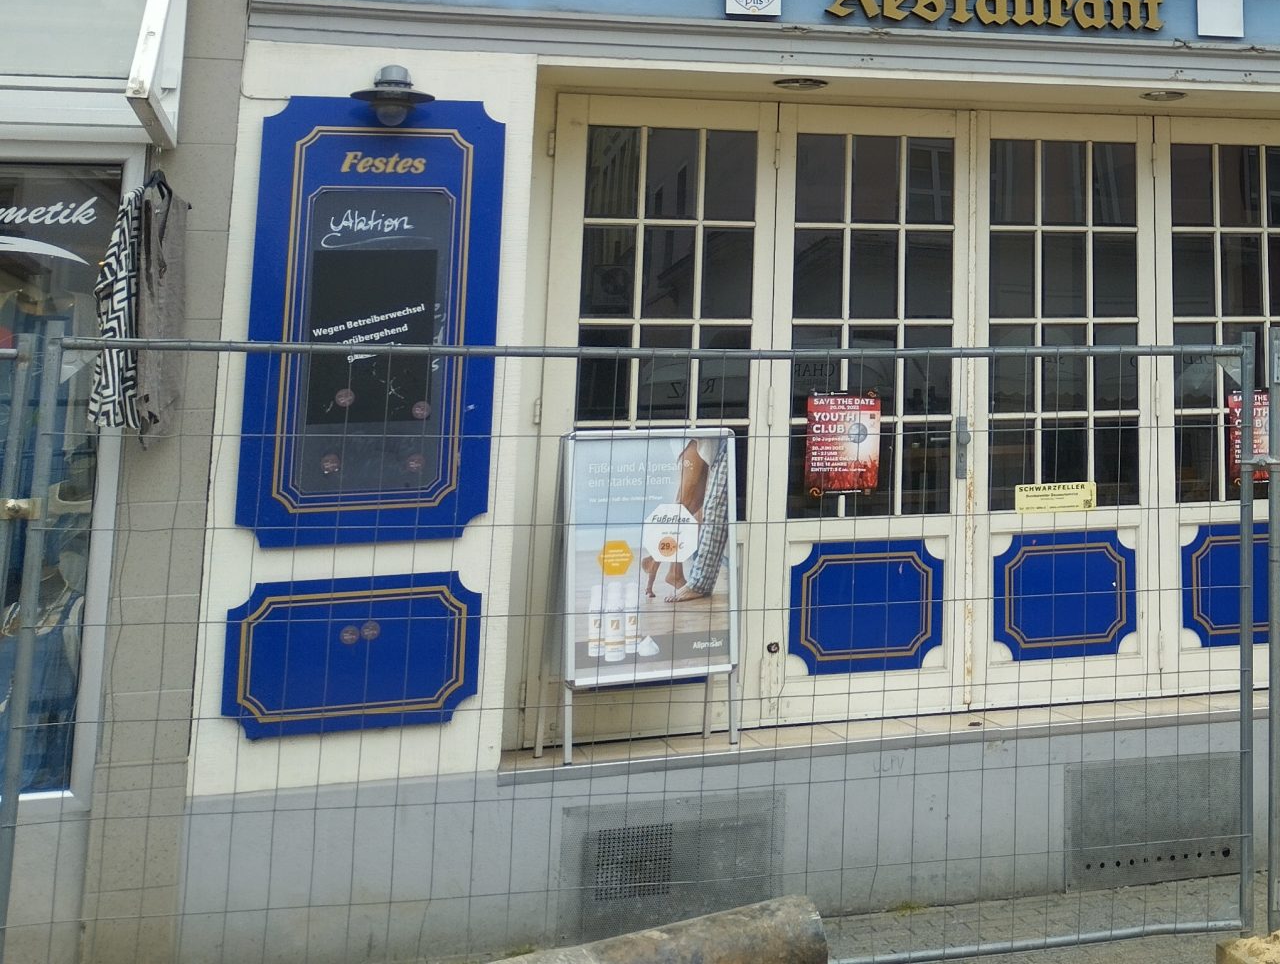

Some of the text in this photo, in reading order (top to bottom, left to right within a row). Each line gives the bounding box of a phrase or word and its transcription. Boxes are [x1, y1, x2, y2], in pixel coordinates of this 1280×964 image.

[341, 151, 426, 174] Festes
[312, 303, 426, 337] Wegen Betreiberwechsel
[813, 412, 856, 422] YOUTH
[812, 424, 845, 434] CLUB
[617, 462, 636, 473] und
[588, 478, 604, 488] ein
[608, 475, 643, 487] starkes
[1019, 484, 1085, 493] SCHWARZFELLER
